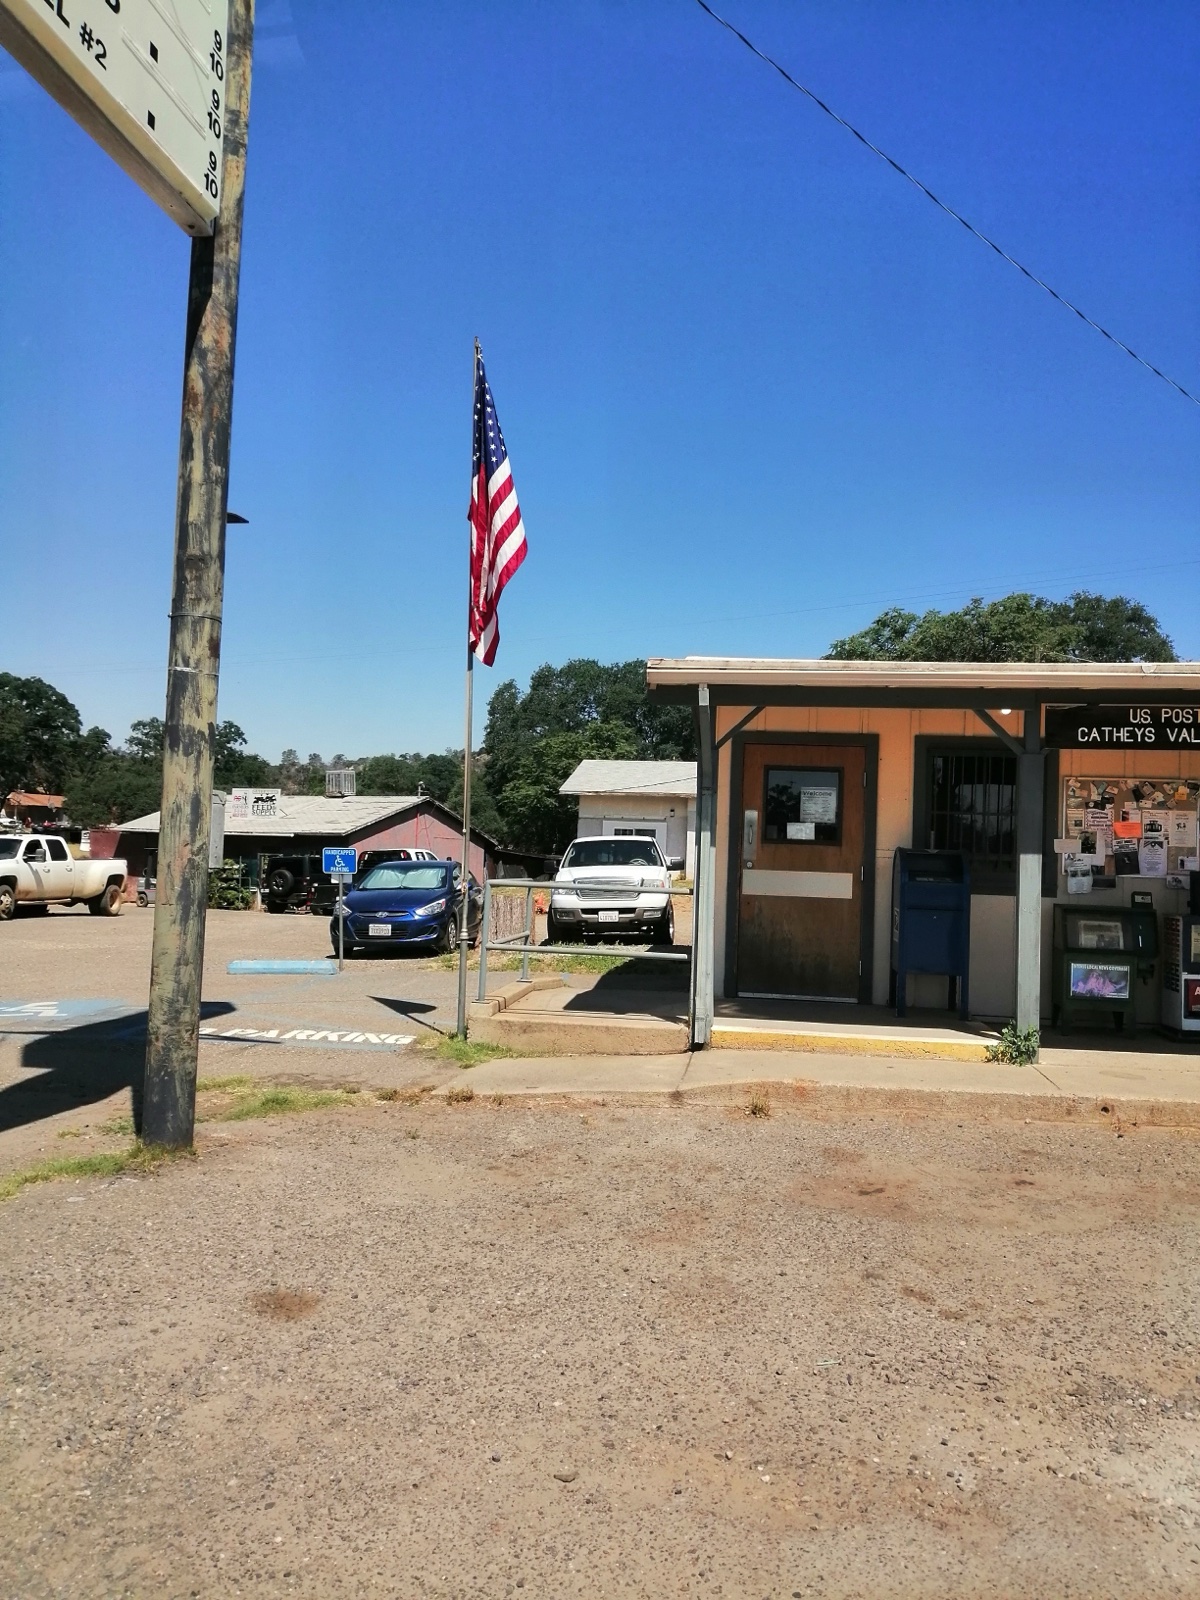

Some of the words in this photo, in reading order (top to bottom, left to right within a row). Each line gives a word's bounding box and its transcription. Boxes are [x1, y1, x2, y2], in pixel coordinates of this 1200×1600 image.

[80, 22, 106, 70] #2
[1129, 708, 1153, 724] U.S.
[1078, 726, 1155, 742] CATHEYS
[1166, 727, 1200, 743] VAL
[221, 1028, 417, 1045] PARKING
